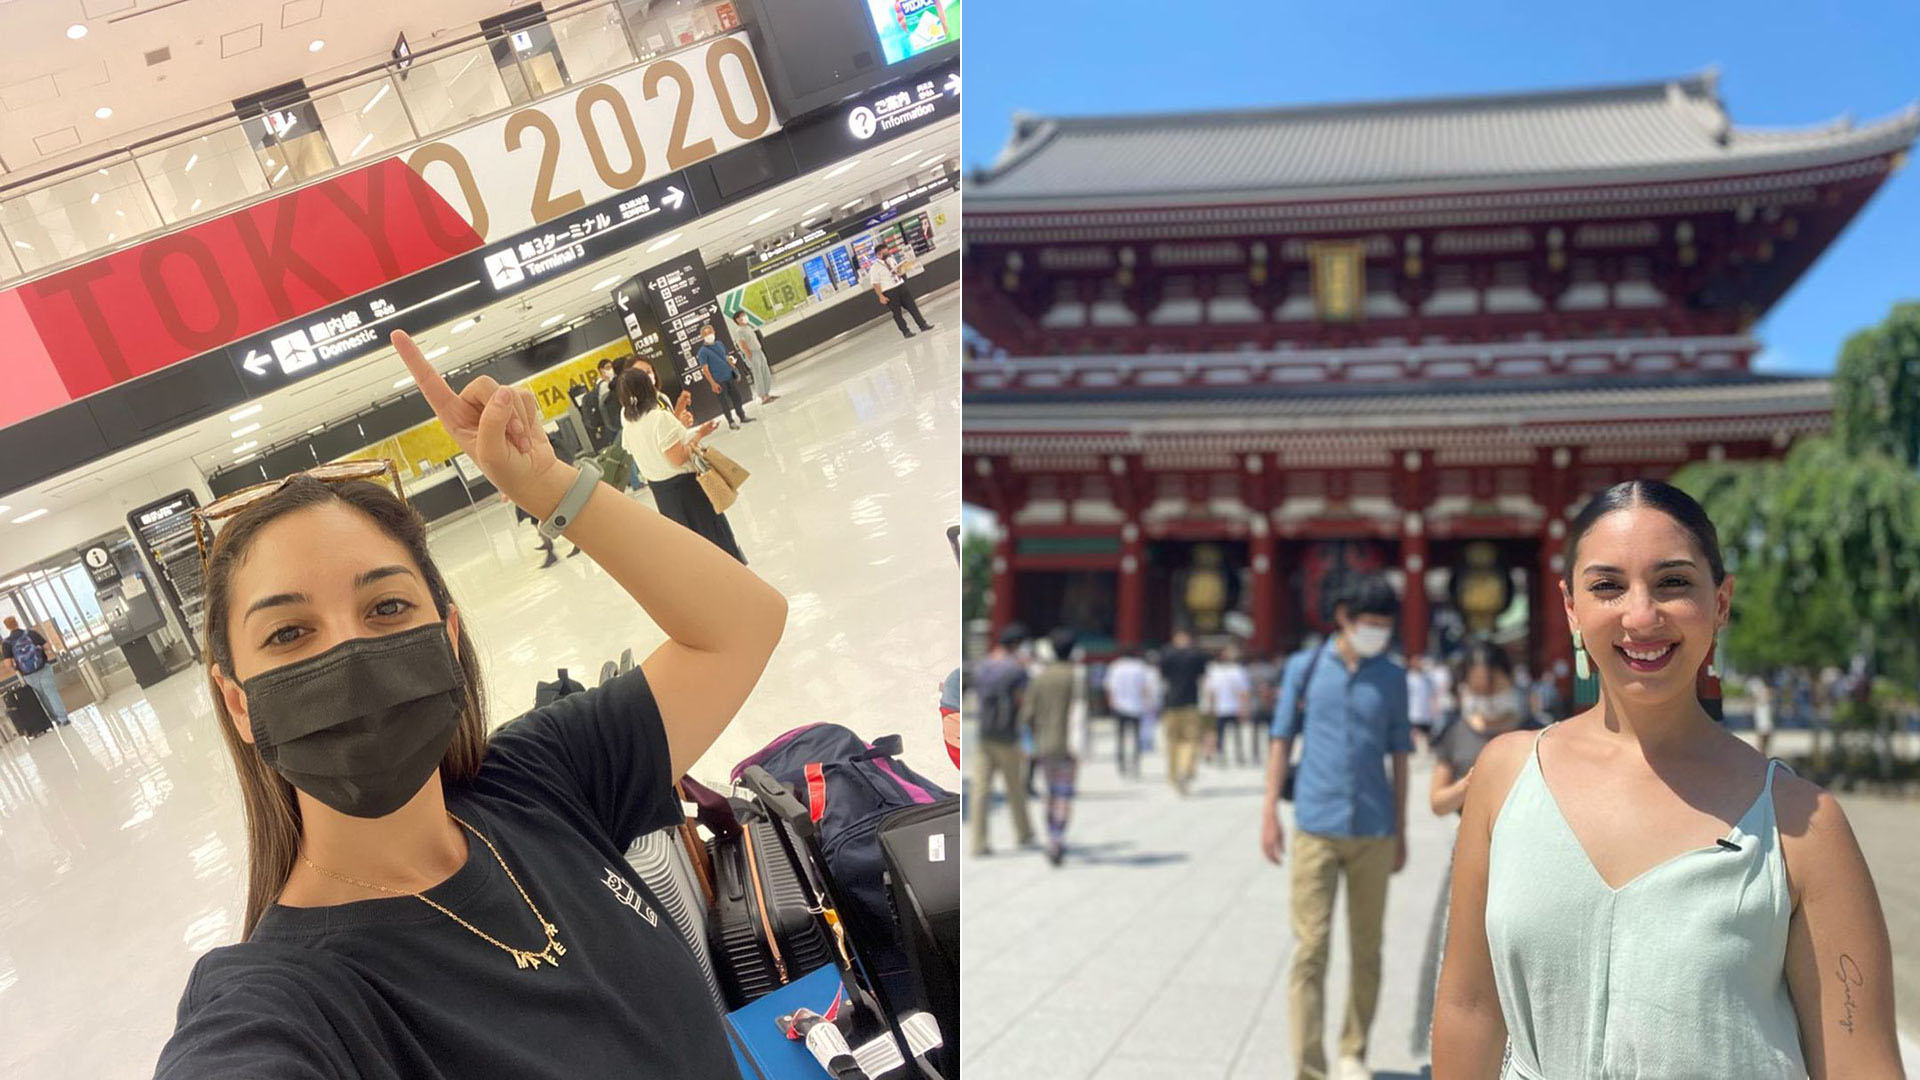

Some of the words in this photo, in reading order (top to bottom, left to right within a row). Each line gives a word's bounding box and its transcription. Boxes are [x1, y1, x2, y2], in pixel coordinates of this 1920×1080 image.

[880, 103, 935, 130] Information
[35, 141, 489, 382] TOKYO
[504, 37, 772, 225] 2020
[526, 247, 577, 276] Terminal
[576, 244, 585, 257] 3
[318, 328, 378, 360] Domestic
